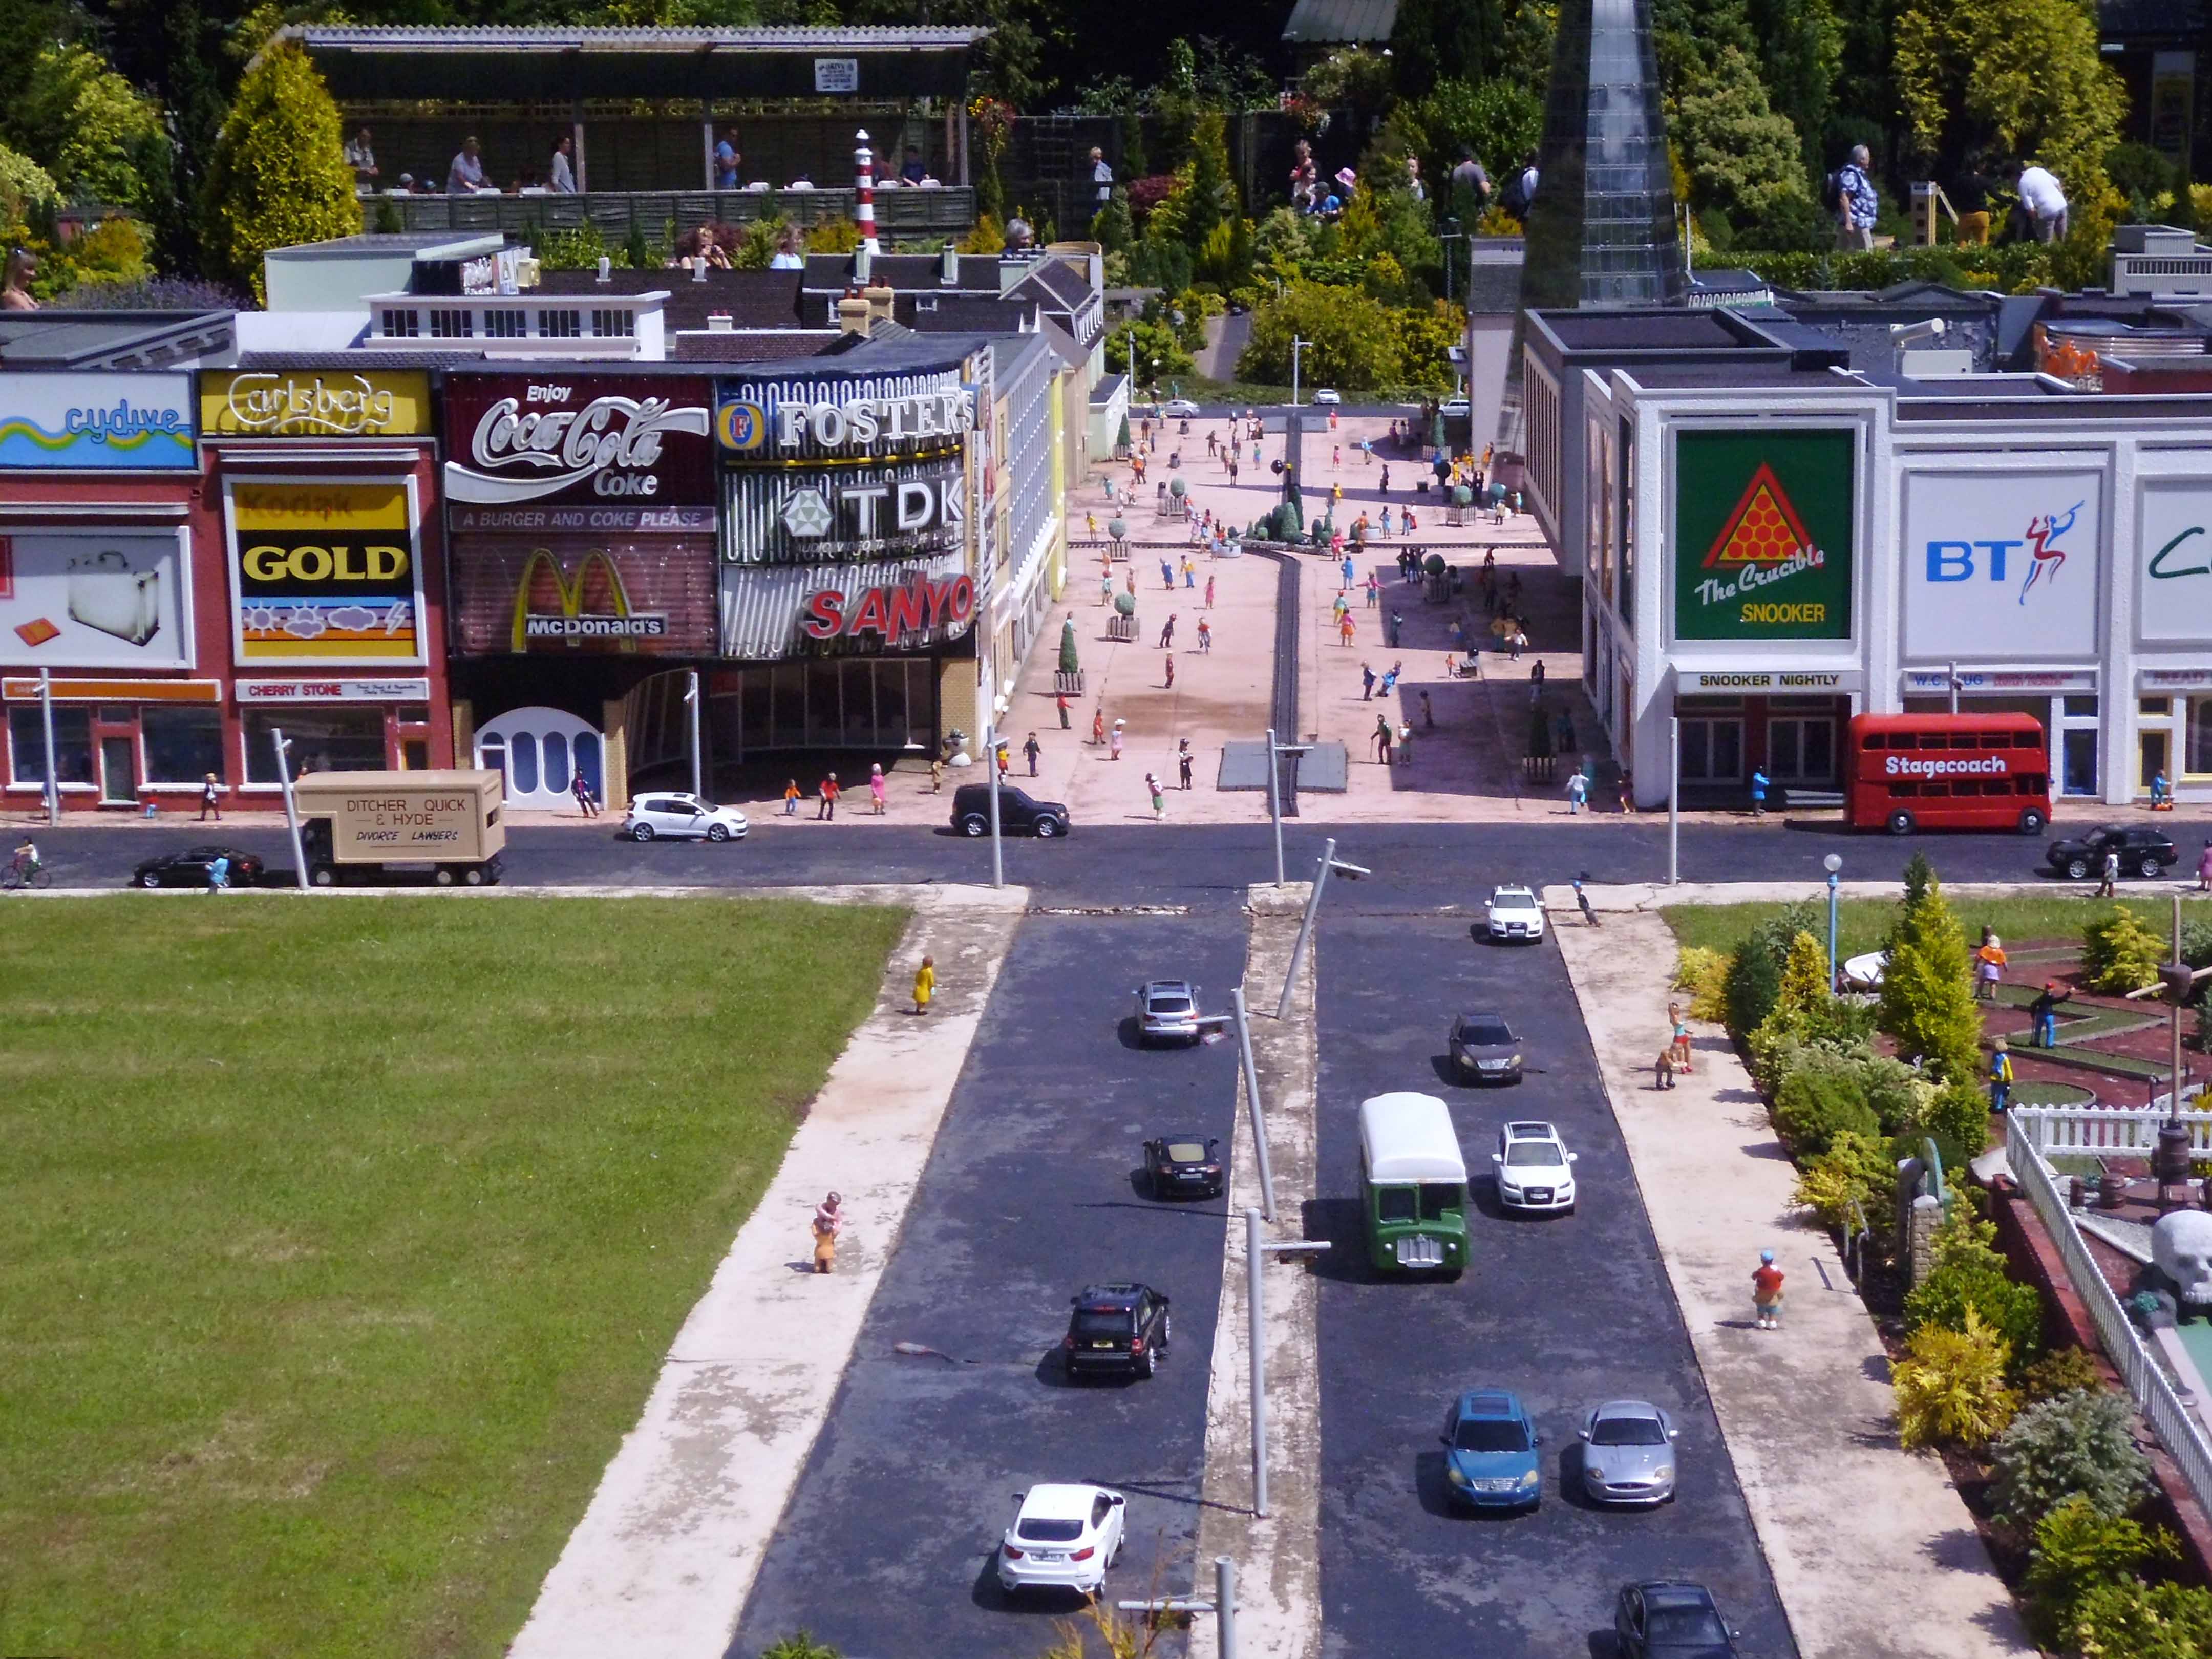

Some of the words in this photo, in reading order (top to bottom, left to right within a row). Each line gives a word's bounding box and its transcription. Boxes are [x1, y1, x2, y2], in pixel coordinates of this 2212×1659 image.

[527, 384, 572, 402] Enjoy
[229, 373, 393, 434] Carlsberg
[594, 469, 657, 496] Coke
[843, 476, 963, 536] TDK
[463, 514, 474, 526] A
[480, 512, 544, 527] BURGER
[551, 513, 584, 526] AND
[589, 513, 635, 526] COKE
[640, 512, 701, 526] PLEASE
[243, 546, 409, 581] GOLD
[1926, 540, 2024, 582] BT
[1694, 578, 1736, 606] The
[1738, 544, 1825, 592] Crucible
[807, 573, 974, 644] SANYO
[1741, 604, 1825, 623] SNOOKER
[527, 618, 662, 635] McDonald's
[1700, 674, 1770, 686] SNOOKER
[1779, 674, 1839, 686] NIGHTLY
[1915, 674, 1945, 687] W.C.
[249, 685, 296, 696] CHERRY
[303, 684, 342, 696] STONE
[1886, 756, 2006, 779] Stagecoach
[347, 800, 406, 812] DITCHER
[425, 799, 465, 811] QUICK
[393, 814, 434, 825] HYDE
[356, 831, 399, 840] DIVORCE
[412, 831, 458, 840] LAWYERS
